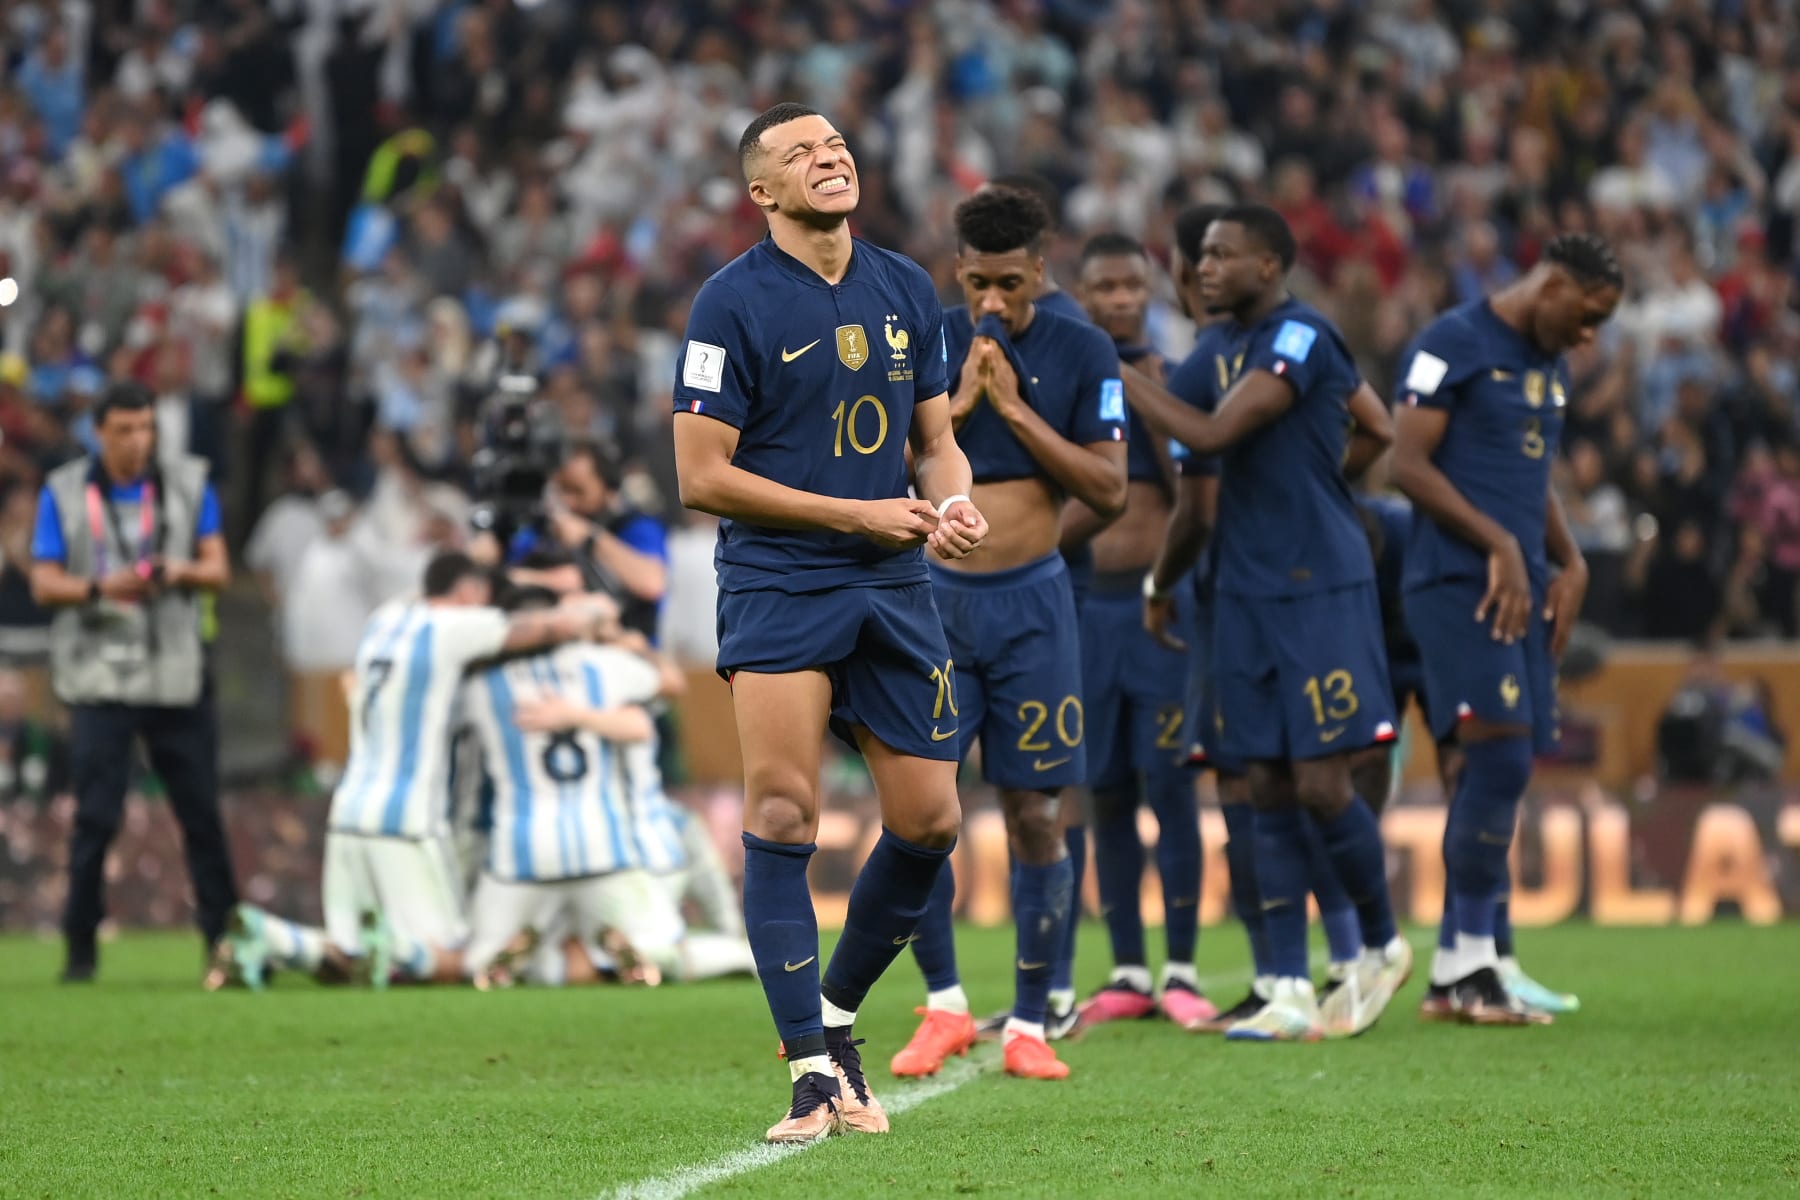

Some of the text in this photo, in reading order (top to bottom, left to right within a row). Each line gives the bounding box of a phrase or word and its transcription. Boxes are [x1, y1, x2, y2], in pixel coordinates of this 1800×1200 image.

[831, 394, 888, 457] 10
[360, 657, 394, 733] 7
[1017, 695, 1084, 751] 20
[1304, 669, 1360, 725] 13
